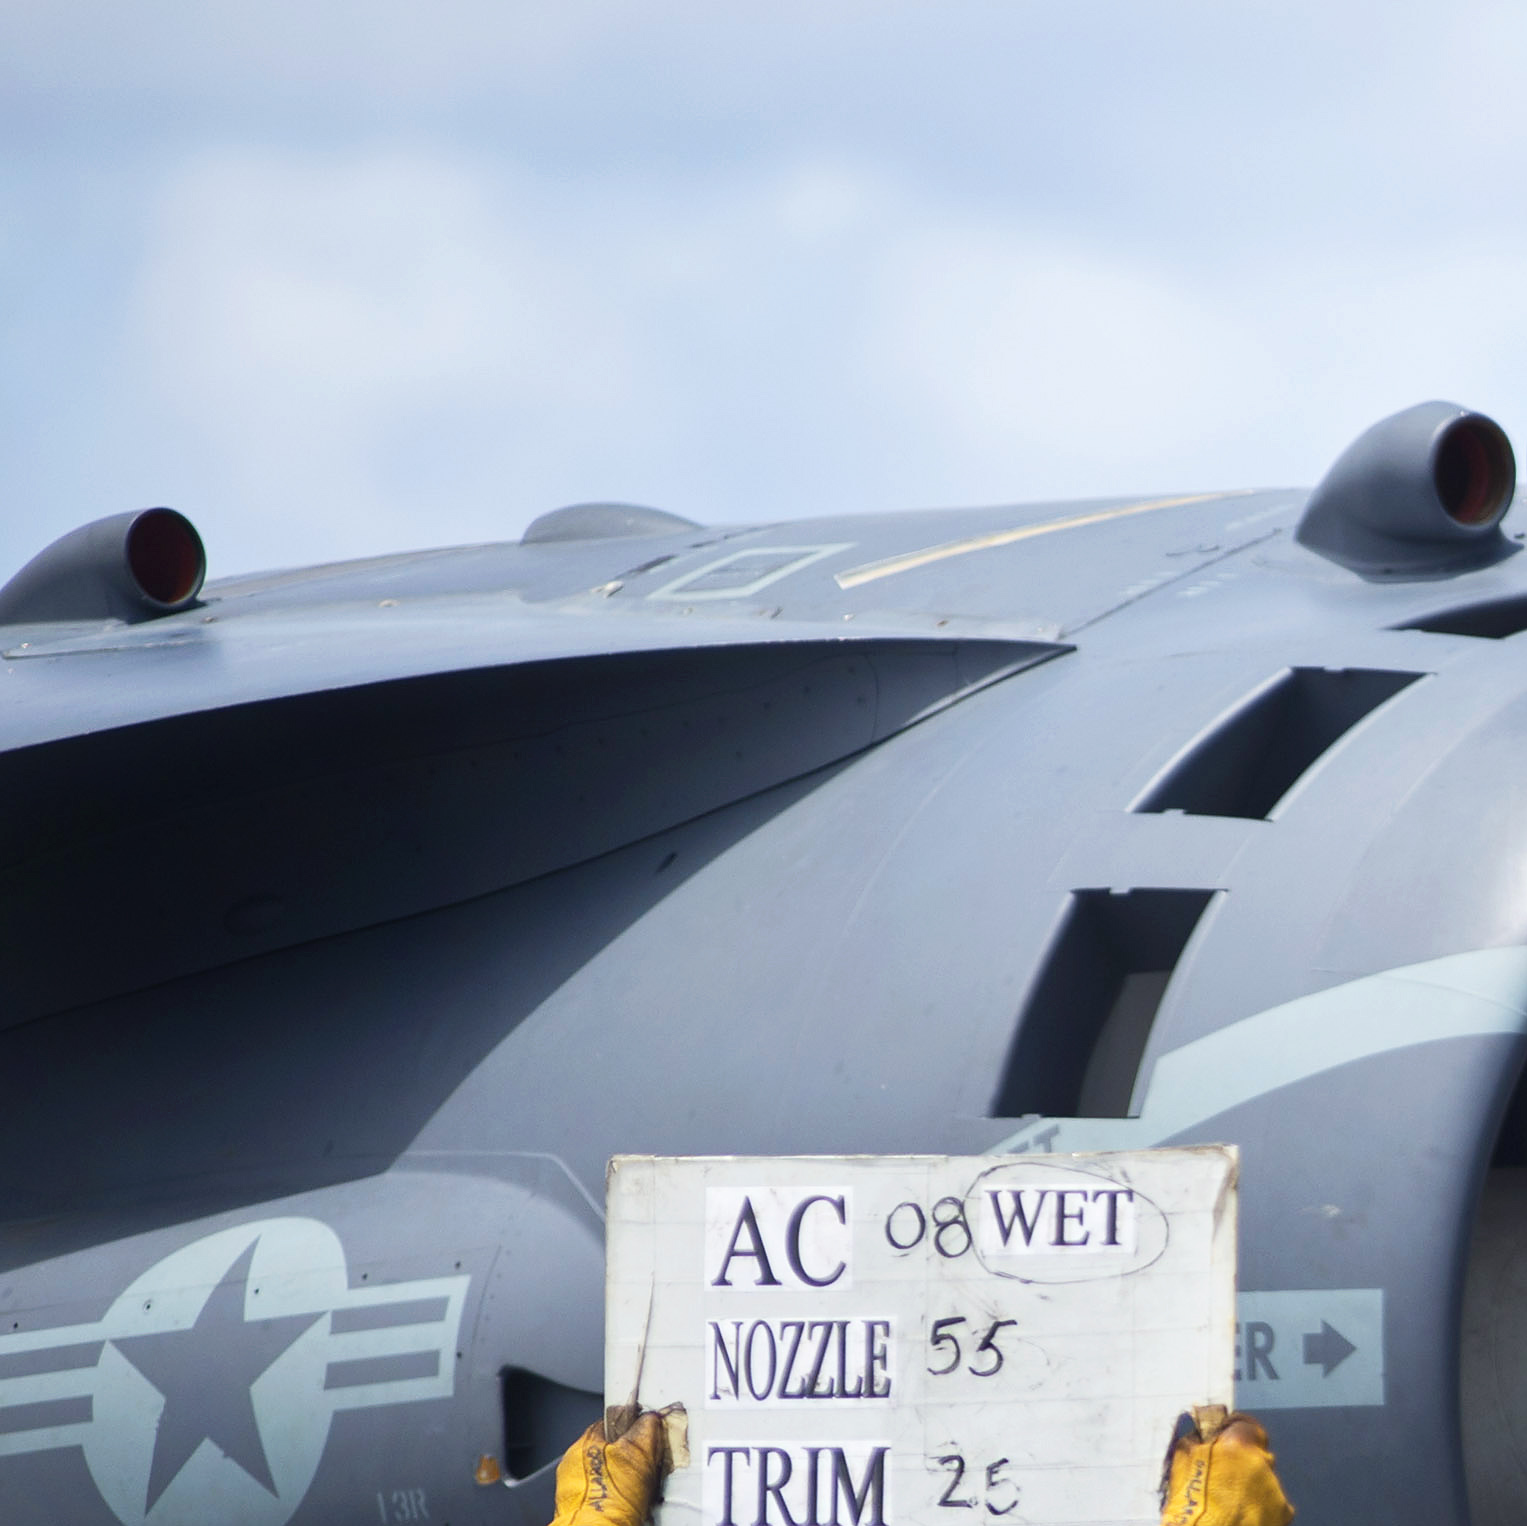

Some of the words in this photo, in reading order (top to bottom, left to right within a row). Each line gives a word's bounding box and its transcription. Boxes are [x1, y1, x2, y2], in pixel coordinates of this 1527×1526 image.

[710, 1194, 847, 1287] AC
[885, 1196, 972, 1259] 08
[984, 1188, 1134, 1249] WET
[708, 1319, 892, 1401] NOZZLE
[926, 1316, 1019, 1377] 55
